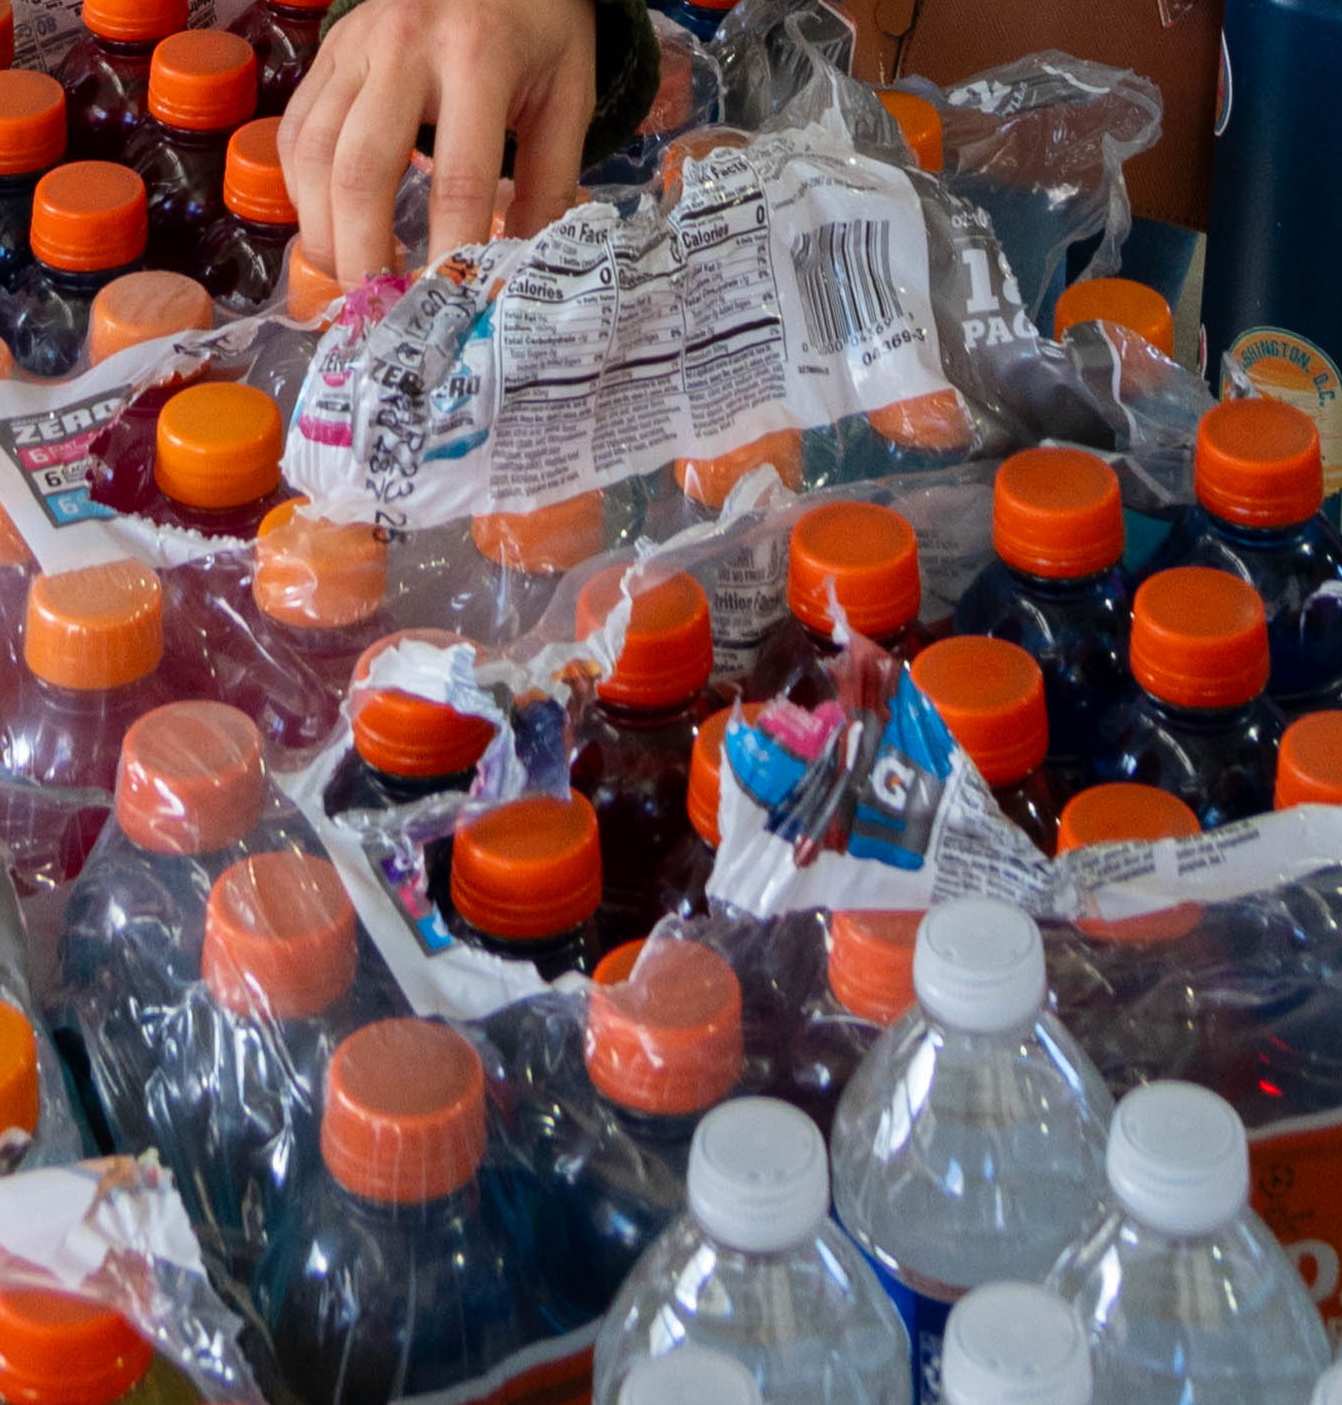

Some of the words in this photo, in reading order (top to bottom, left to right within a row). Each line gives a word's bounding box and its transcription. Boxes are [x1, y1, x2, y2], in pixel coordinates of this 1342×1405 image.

[756, 204, 765, 224] 0
[682, 224, 729, 249] Calories
[600, 267, 610, 285] 0
[508, 281, 564, 301] Calories
[1239, 340, 1312, 374] SHINGTON,
[29, 447, 50, 465] 6
[44, 470, 62, 489] 6
[58, 493, 79, 517] 6
